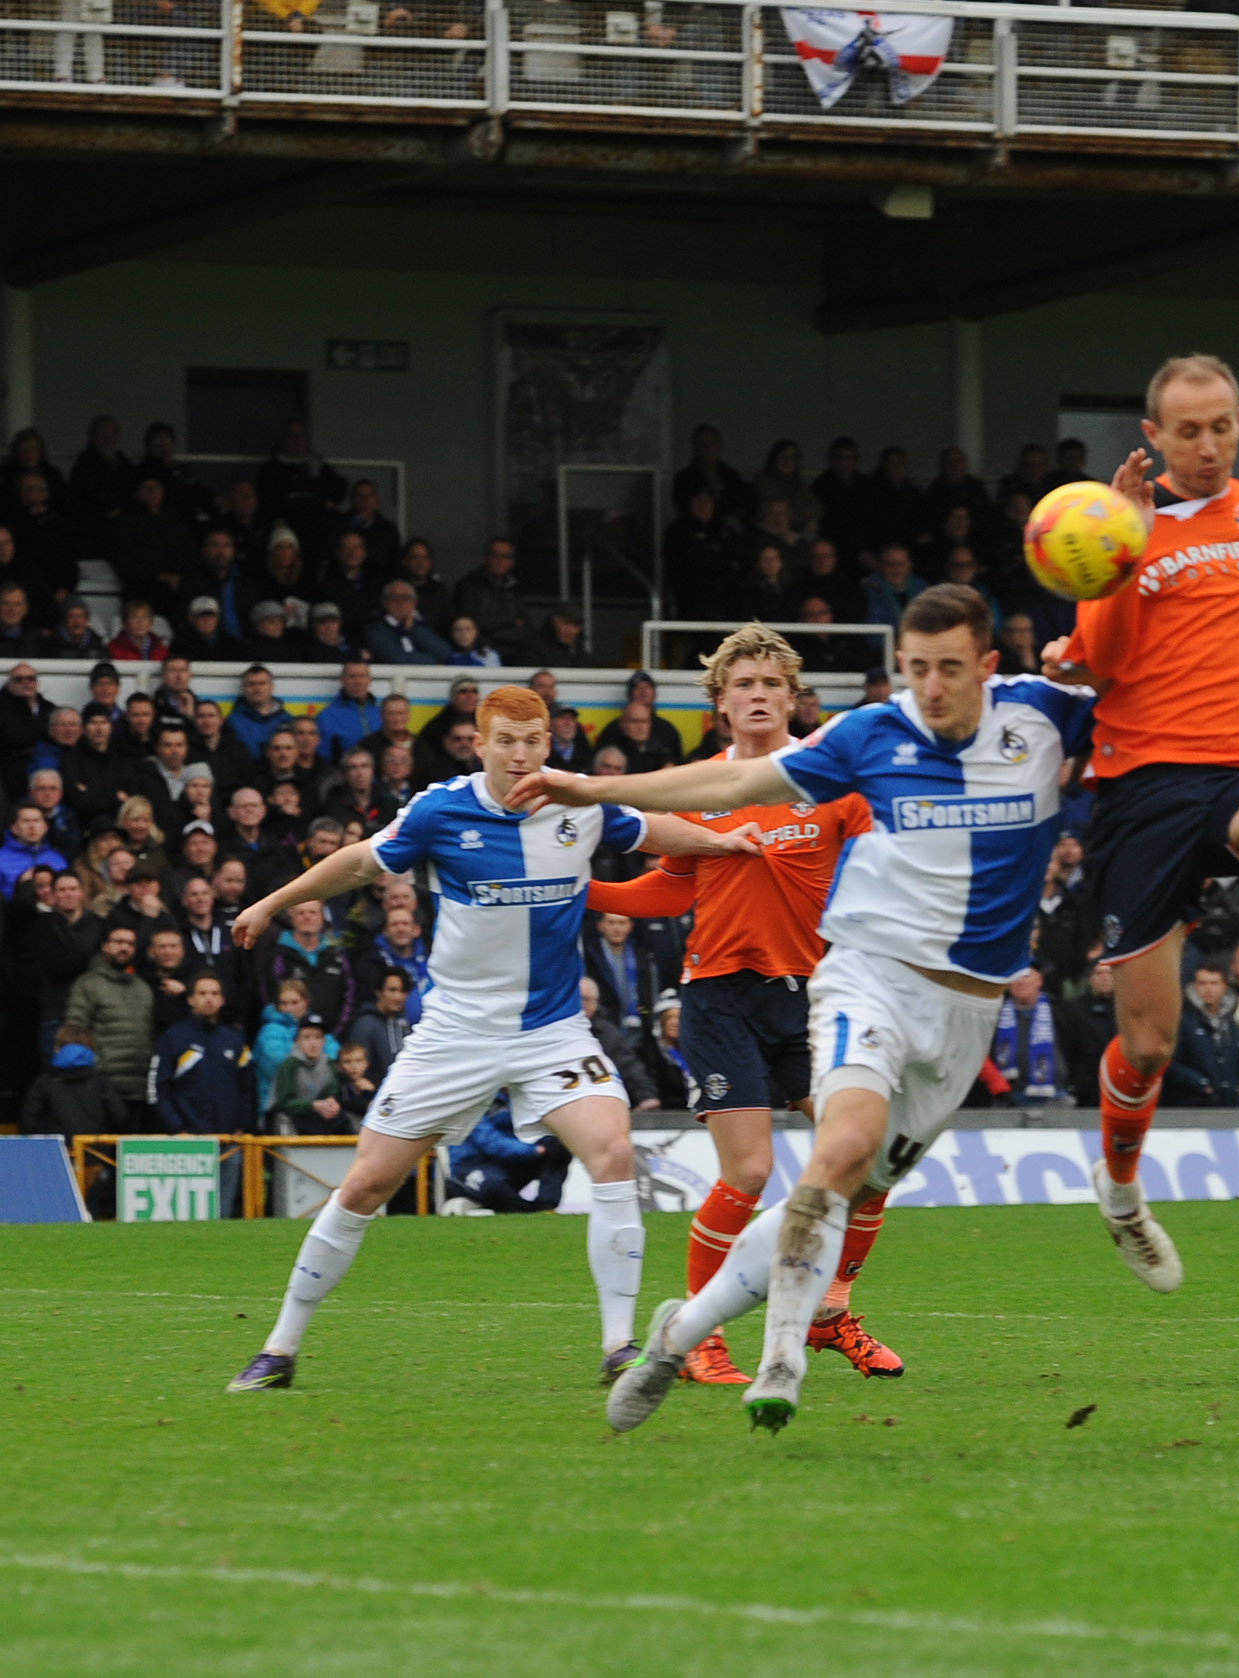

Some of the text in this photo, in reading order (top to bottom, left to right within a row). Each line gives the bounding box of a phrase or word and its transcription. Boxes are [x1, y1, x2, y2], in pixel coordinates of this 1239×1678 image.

[899, 800, 1033, 829] SPORTSMAN
[762, 823, 820, 846] FIELD
[124, 1153, 214, 1175] EMERGENCY
[888, 1133, 924, 1178] 4
[124, 1177, 217, 1222] EXIT
